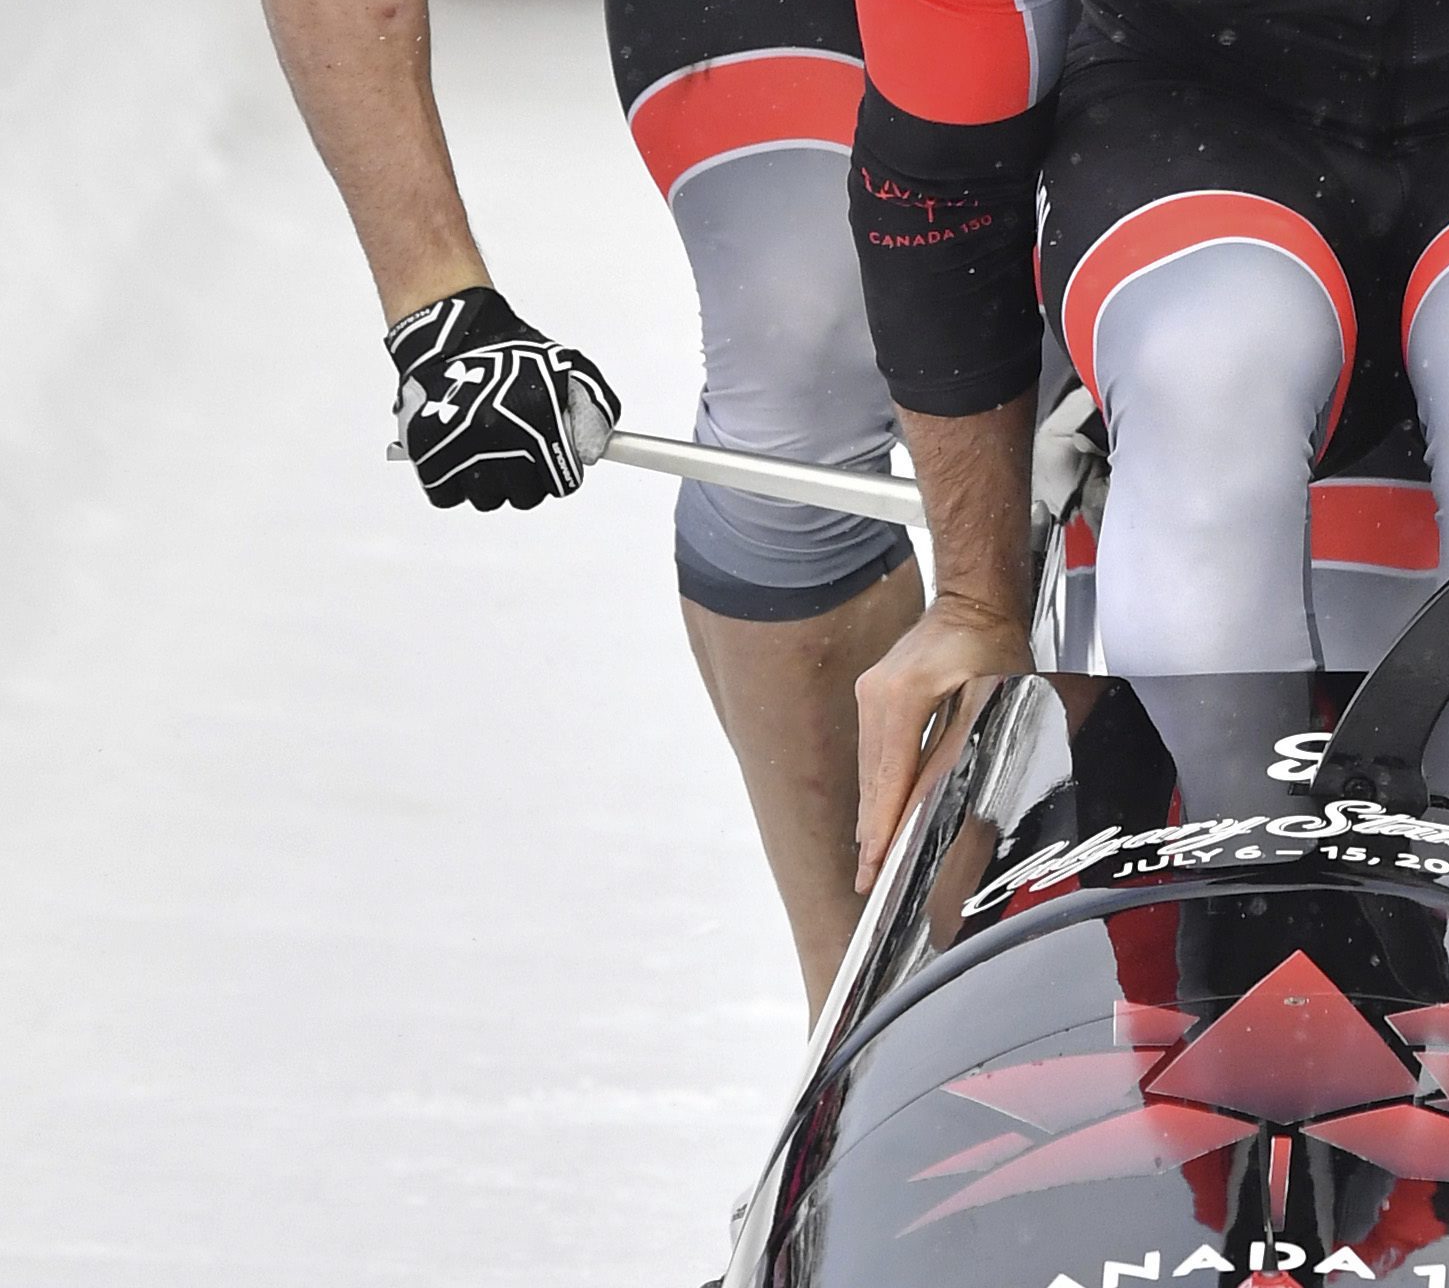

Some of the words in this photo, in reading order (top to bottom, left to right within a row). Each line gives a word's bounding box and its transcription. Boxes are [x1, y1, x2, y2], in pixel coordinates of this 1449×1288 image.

[869, 228, 955, 248] CANADA
[960, 214, 993, 233] 150
[1113, 847, 1223, 879] JULY
[1235, 844, 1263, 860] 6
[1319, 844, 1381, 866] 15,
